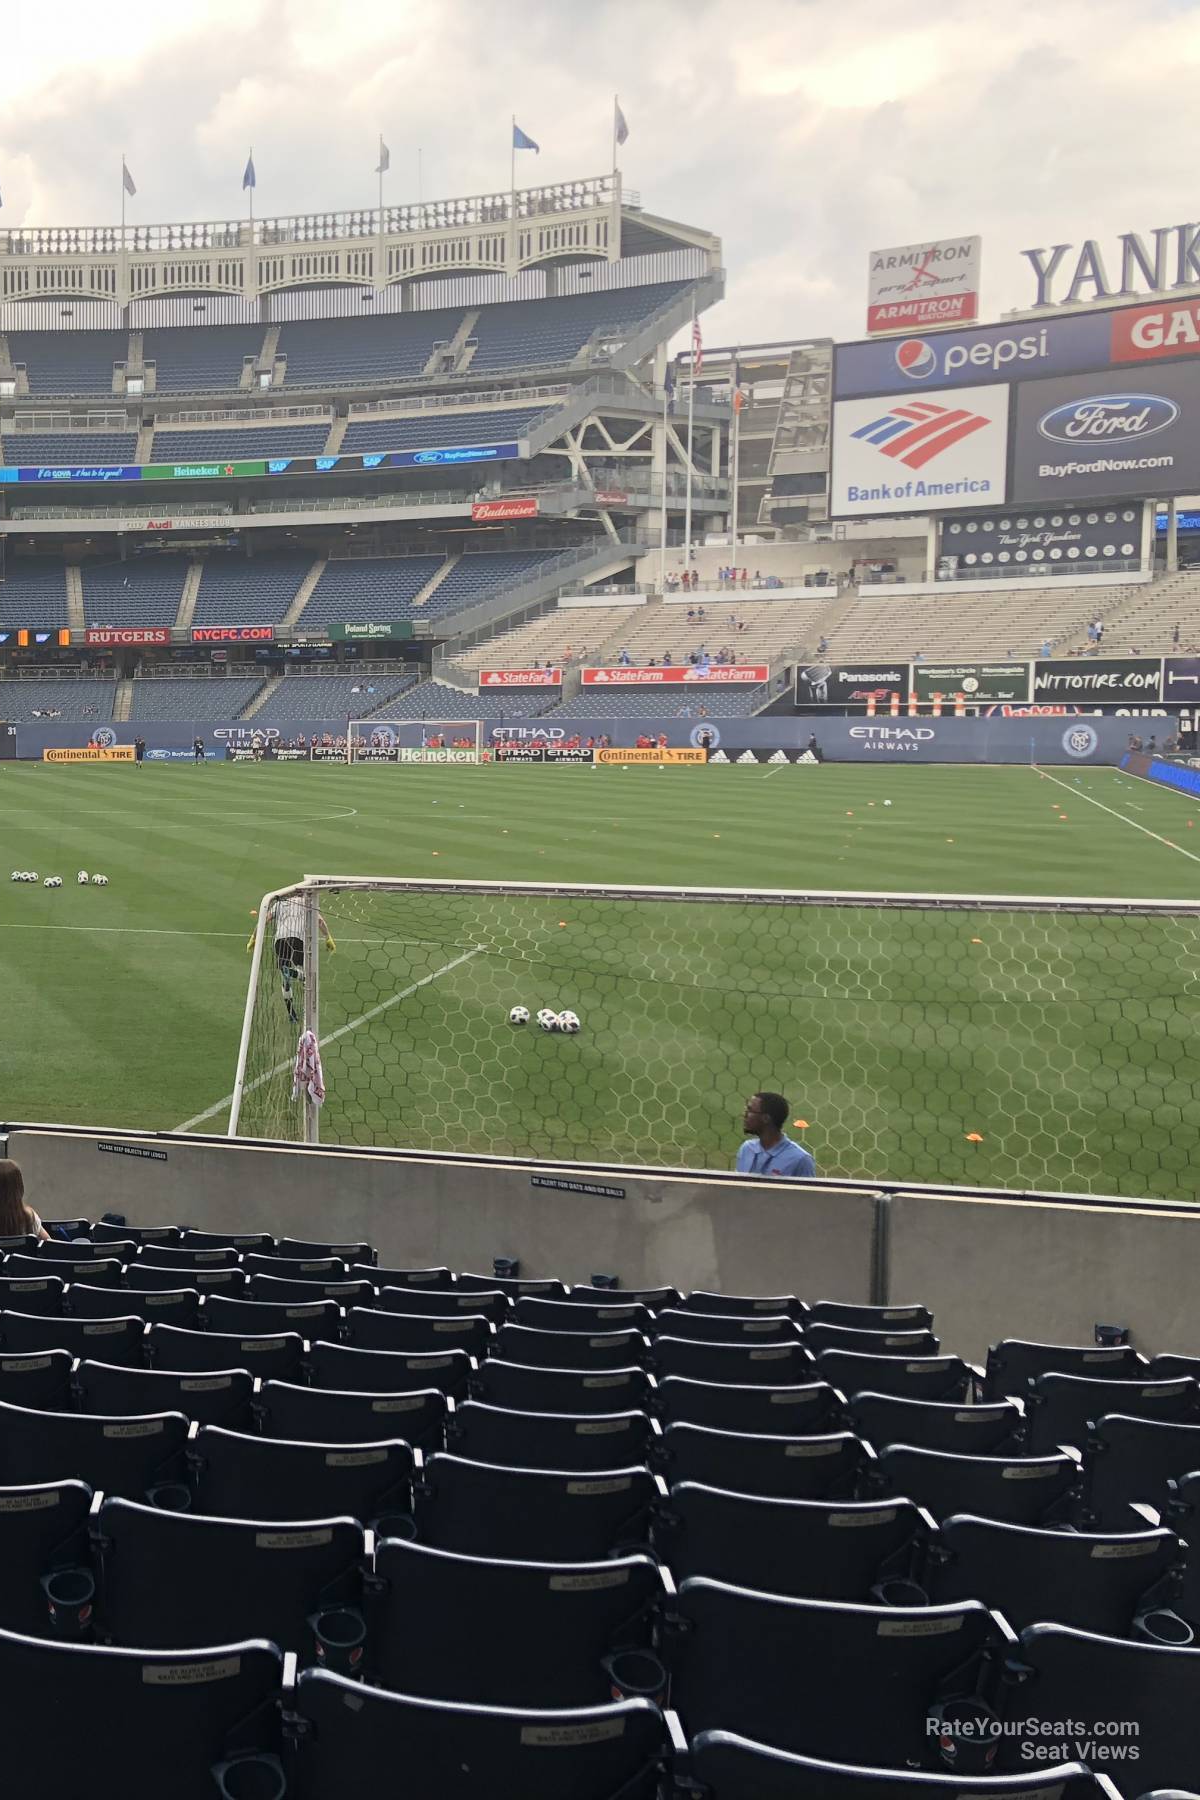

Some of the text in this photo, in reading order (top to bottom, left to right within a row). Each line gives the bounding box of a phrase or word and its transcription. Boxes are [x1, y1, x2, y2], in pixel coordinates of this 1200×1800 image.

[872, 245, 972, 271] ARMITRON
[875, 297, 966, 320] ARMITRON
[918, 310, 961, 320] WATCHES
[1131, 309, 1200, 349] GA
[944, 329, 1049, 375] pepsi
[1065, 402, 1150, 437] Ford
[269, 463, 286, 472] SAP
[315, 460, 334, 470] SAP
[363, 457, 380, 467] SAP
[1039, 455, 1174, 477] BuyFordNow.com
[174, 466, 219, 476] Heineken
[847, 478, 990, 502] Bank of America
[473, 504, 535, 518] Budweiser
[147, 518, 230, 529] Audi YANKEES CLUB
[193, 628, 273, 641] NYCFC.COM
[345, 622, 392, 636] Poland Spring
[89, 629, 166, 645] RUTGERS
[610, 670, 663, 681] State Farm
[727, 669, 756, 680] Farm
[839, 671, 902, 682] Panasonic
[1035, 672, 1160, 690] NITTOTIRE.COM
[213, 728, 280, 739] ETIHAD
[492, 728, 565, 739] ETIHAD
[850, 727, 934, 740] ETIHAD
[358, 748, 395, 756] ETIHAD
[864, 743, 919, 751] AIRWAYS
[46, 750, 133, 761] Continental TIRE
[400, 748, 477, 763] Heineken
[598, 750, 702, 762] Continental TIRE
